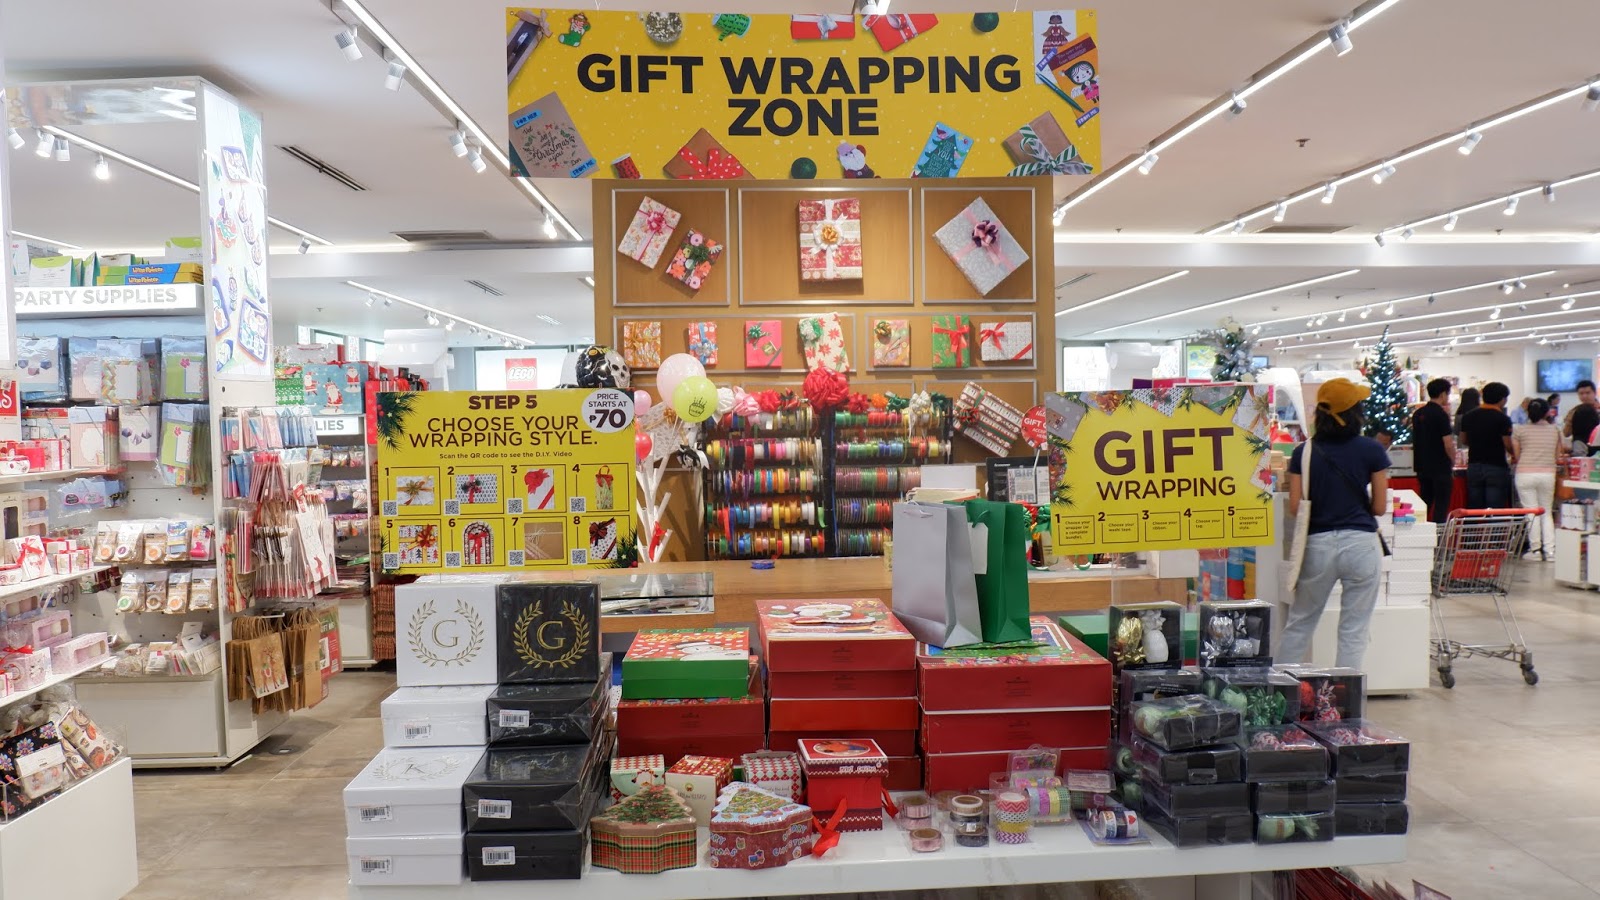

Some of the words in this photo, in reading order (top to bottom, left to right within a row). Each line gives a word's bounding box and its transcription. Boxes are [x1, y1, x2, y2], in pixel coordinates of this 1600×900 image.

[576, 54, 704, 94] GIFT
[719, 54, 1021, 95] WRAPPING
[516, 117, 527, 126] FOR
[527, 112, 538, 120] HER
[728, 98, 880, 137] ZONE
[537, 138, 570, 160] Christmas
[572, 164, 586, 176] FROM
[585, 159, 594, 168] ME
[14, 291, 77, 306] PARTY
[82, 288, 177, 305] SUPPLIES
[508, 367, 536, 380] LEGO
[468, 395, 520, 410] STEP
[525, 394, 538, 409] 5
[588, 400, 617, 408] STARTS
[618, 400, 627, 408] AT
[315, 420, 345, 431] LIES
[427, 417, 515, 432] CHOOSE
[522, 415, 579, 430] YOUR
[1024, 417, 1042, 427] GIFT
[409, 431, 523, 448] WRAPPING
[530, 430, 598, 445] STYLE.
[1094, 427, 1234, 476] GIFT
[384, 467, 390, 476] 1
[447, 466, 455, 475] 2
[510, 465, 518, 474] 3
[572, 464, 580, 473] 4
[1096, 476, 1236, 501] WRAPPING
[1142, 510, 1150, 520] 3
[1183, 508, 1192, 518] 4
[1227, 506, 1235, 516] 5
[512, 517, 519, 526] 7
[573, 516, 581, 525] 8
[1055, 513, 1060, 524] 1
[1098, 512, 1106, 522] 2
[386, 520, 393, 529] 5
[448, 519, 456, 528] 6
[432, 619, 459, 649] G
[536, 620, 565, 650] G
